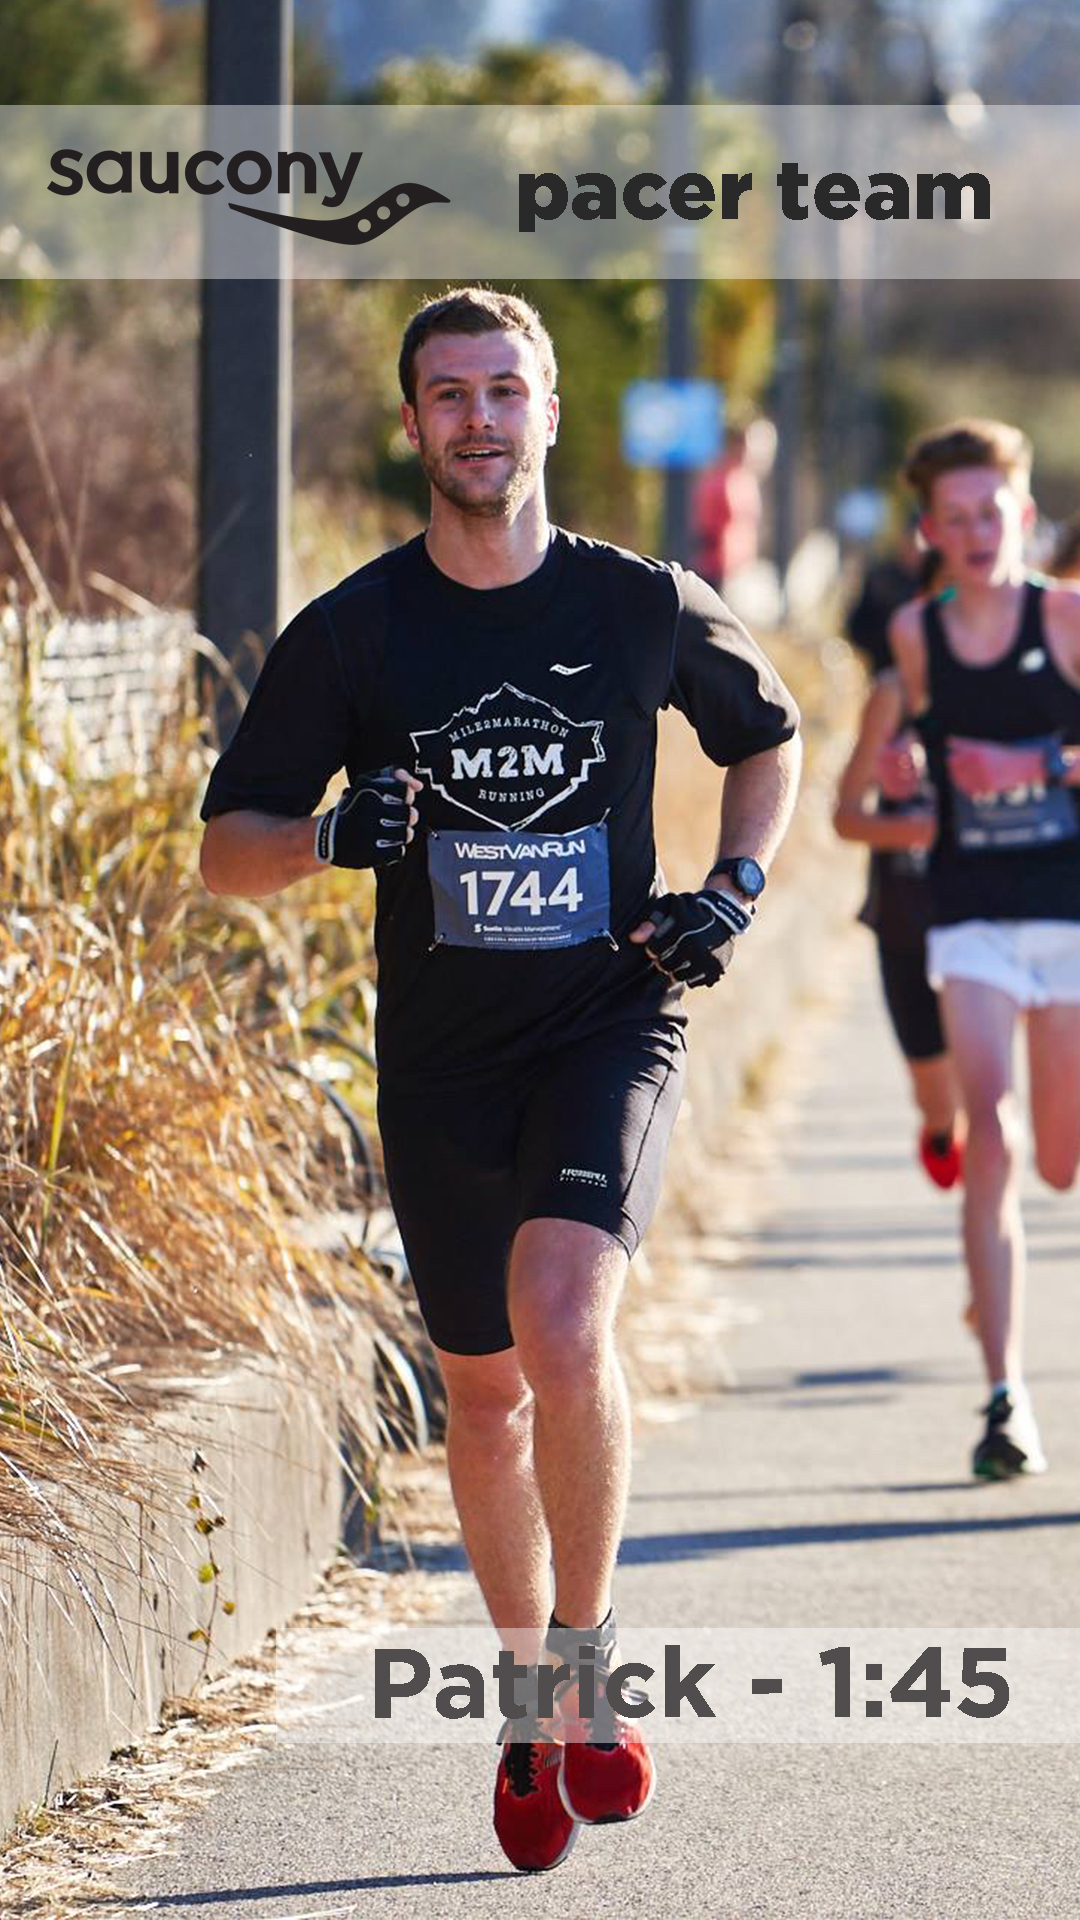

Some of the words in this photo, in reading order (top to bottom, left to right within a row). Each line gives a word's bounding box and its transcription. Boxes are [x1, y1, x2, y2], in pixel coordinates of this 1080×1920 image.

[449, 716, 570, 743] MILE2MARATHON
[451, 743, 565, 780] M2M
[478, 788, 546, 803] RUNNING
[459, 867, 584, 916] 1744
